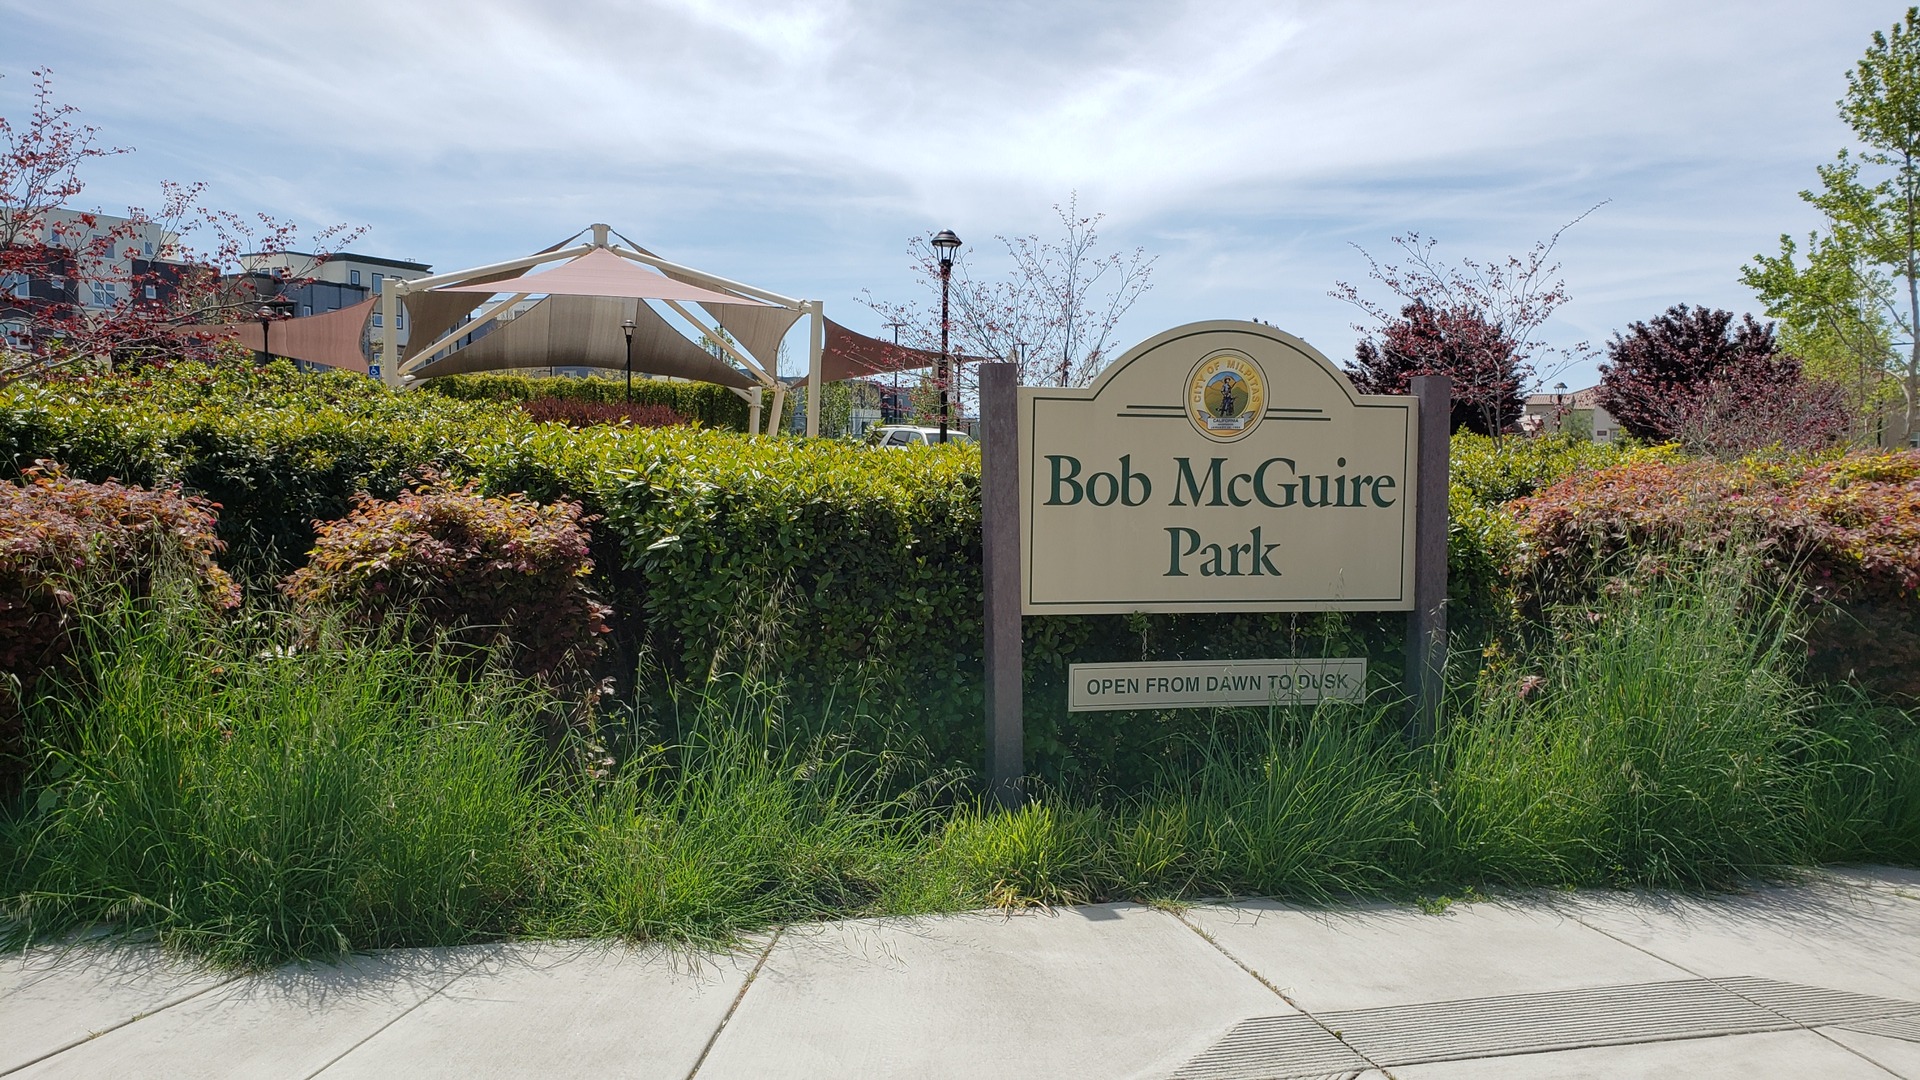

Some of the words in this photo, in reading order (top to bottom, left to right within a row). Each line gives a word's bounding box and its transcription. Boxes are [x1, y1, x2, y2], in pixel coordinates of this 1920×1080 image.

[1193, 374, 1206, 402] CITY
[1207, 362, 1220, 374] OF
[1226, 360, 1260, 403] MILPITAS
[1043, 454, 1152, 508] Bob
[1168, 457, 1397, 508] McGuire
[1163, 526, 1282, 577] Park
[1087, 678, 1139, 695] OPEN
[1146, 676, 1200, 693] FROM
[1206, 675, 1262, 692] DAWN
[1267, 675, 1292, 690] TO
[1298, 674, 1349, 690] DUSK
